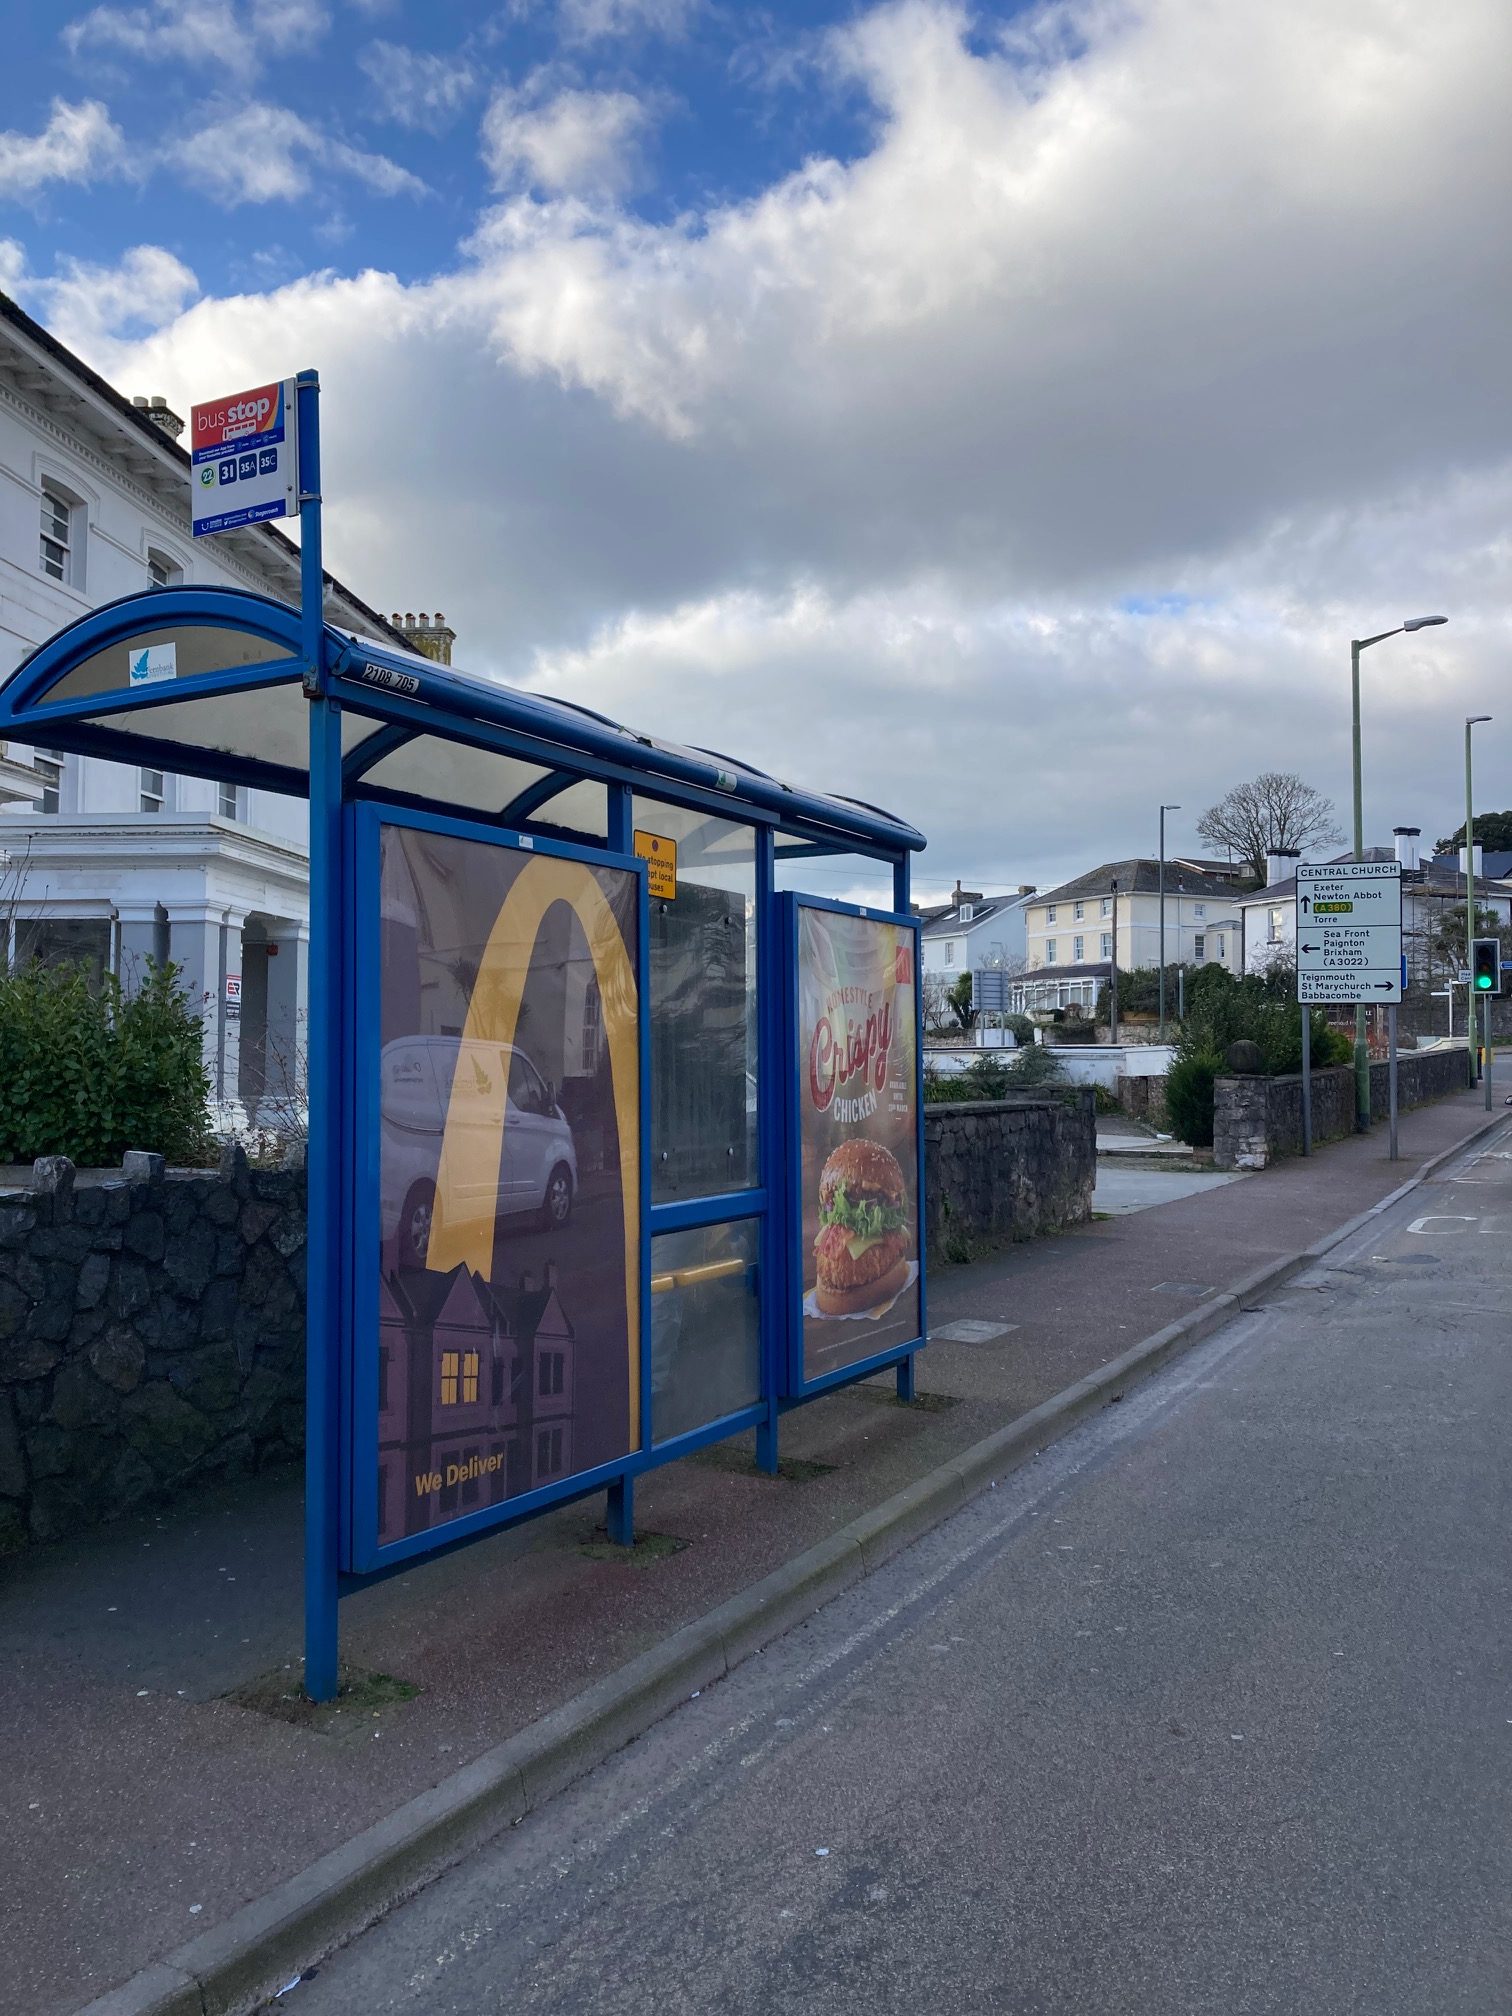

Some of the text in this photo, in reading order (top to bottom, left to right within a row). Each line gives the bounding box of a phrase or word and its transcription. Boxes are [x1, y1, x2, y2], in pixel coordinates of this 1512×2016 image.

[198, 397, 270, 431] bus stop
[202, 454, 276, 483] 22 31 35A 35C
[364, 665, 415, 691] 2108 705
[1300, 865, 1397, 877] CENTRAL CHURCH
[1313, 883, 1344, 892] Exeter
[1313, 891, 1382, 901] Newton Abbot
[1314, 903, 1352, 912] (A380)
[1313, 916, 1338, 924] Torre
[1344, 929, 1370, 938] Front
[1323, 939, 1365, 948] Paignton
[1323, 957, 1369, 967] (A3022)
[1301, 974, 1356, 983] Teignmouth
[1301, 983, 1371, 992] St Marychurch
[827, 986, 873, 1016] HOMESTYLE
[1301, 992, 1361, 1000] Babbacombe
[810, 1002, 893, 1112] Crispy
[833, 1088, 878, 1124] CHICKEN
[415, 1452, 504, 1496] We Deliver
